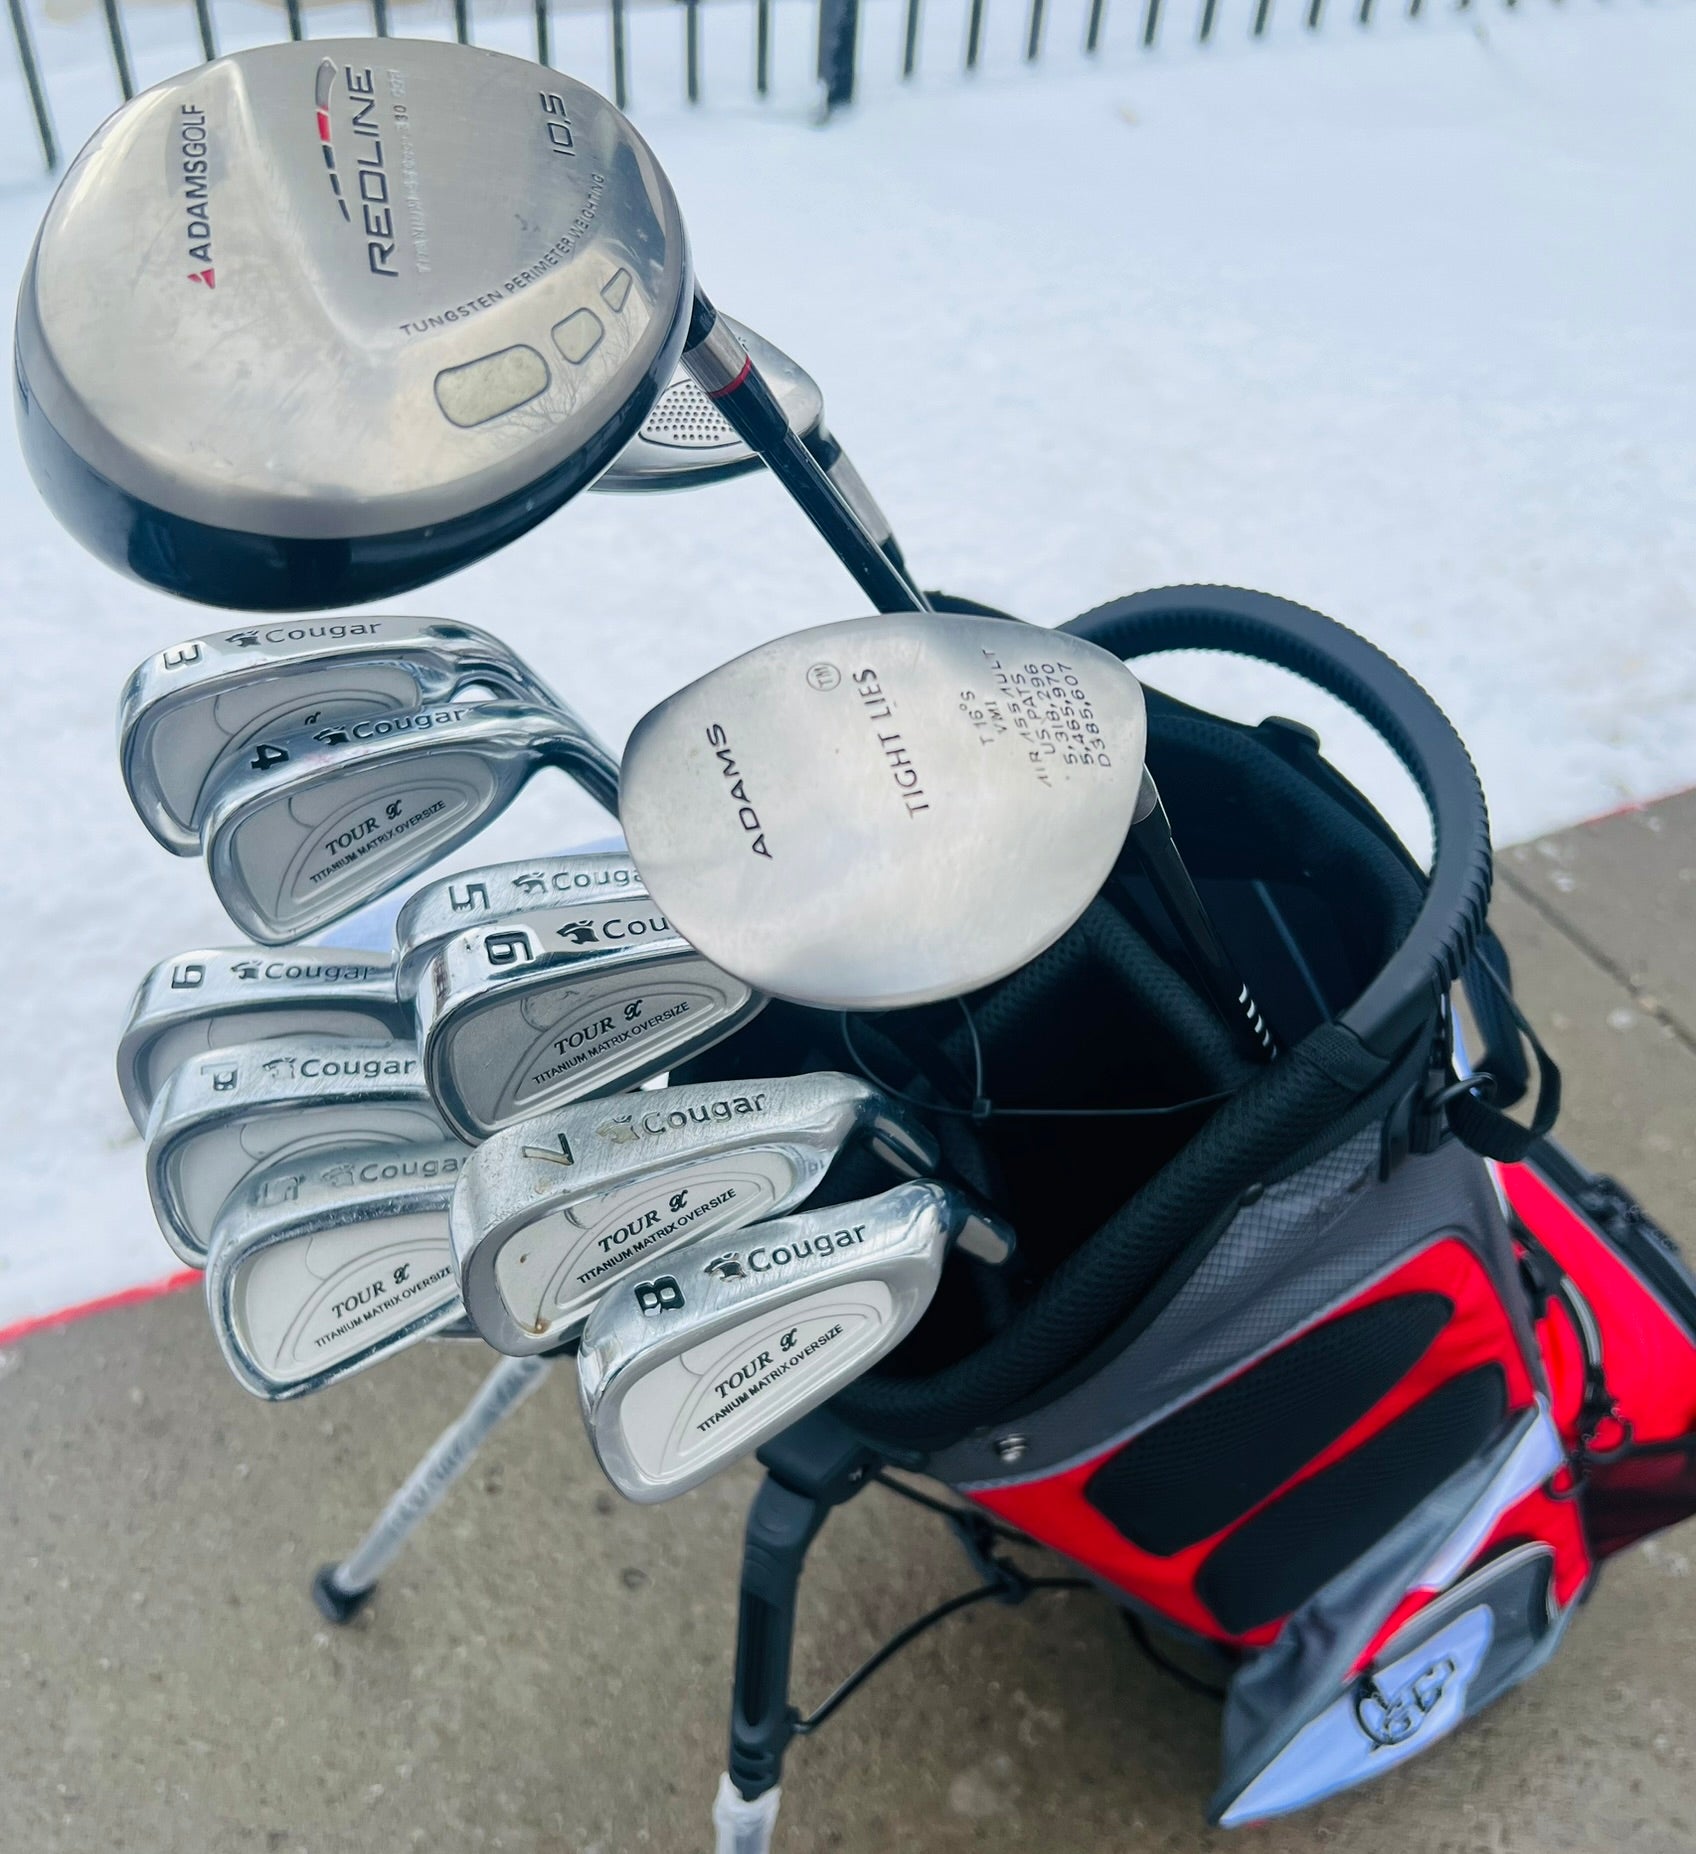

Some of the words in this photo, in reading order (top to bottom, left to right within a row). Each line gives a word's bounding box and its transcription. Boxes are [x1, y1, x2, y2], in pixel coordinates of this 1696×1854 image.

[182, 104, 212, 263] ADAMSGOLF
[345, 65, 399, 277] REDLINE
[400, 290, 504, 336] TUNGSTEN
[504, 236, 576, 294] PERIMETER
[569, 172, 605, 240] WEIGHTING
[163, 643, 201, 670] 3
[265, 621, 382, 645] Cougar
[853, 668, 892, 720] LIES
[1010, 673, 1042, 721] PATS
[1024, 663, 1078, 765] 5,318,296
[1041, 663, 1094, 765] 5,465,970
[251, 743, 290, 771] 4
[350, 707, 467, 739] Cougar
[1035, 729, 1056, 755] US
[706, 723, 773, 859] ADAMS
[877, 733, 929, 819] TIGHT
[310, 849, 358, 883] TITANIUM
[357, 829, 396, 856] MATRIX
[395, 800, 447, 834] OVERSIZE
[325, 817, 380, 856] TOUR
[448, 883, 491, 911] 5
[603, 916, 670, 939] Cou
[265, 962, 376, 984] Cougar
[532, 1053, 588, 1085] TITANIUM
[589, 1030, 633, 1058] MATRIX
[631, 1001, 690, 1036] OVERSIZE
[554, 1016, 616, 1056] TOUR
[300, 1057, 417, 1078] Cougar
[521, 1132, 575, 1167] 7
[641, 1090, 767, 1136] Cougar
[359, 1155, 467, 1183] Couga
[577, 1247, 633, 1284] TITANIUM
[632, 1222, 678, 1252] MATRIX
[677, 1188, 737, 1226] OVERSIZE
[598, 1210, 662, 1253] TOUR
[634, 1275, 686, 1316] 8
[747, 1222, 867, 1273] Cougar
[314, 1316, 363, 1348] TITANIUM
[363, 1294, 403, 1321] MATRIX
[331, 1280, 387, 1318] TOUR
[697, 1392, 750, 1432] TITANIUM
[748, 1362, 791, 1396] MATRIX
[789, 1323, 844, 1366] OVERSIZE
[715, 1350, 774, 1399] TOUR
